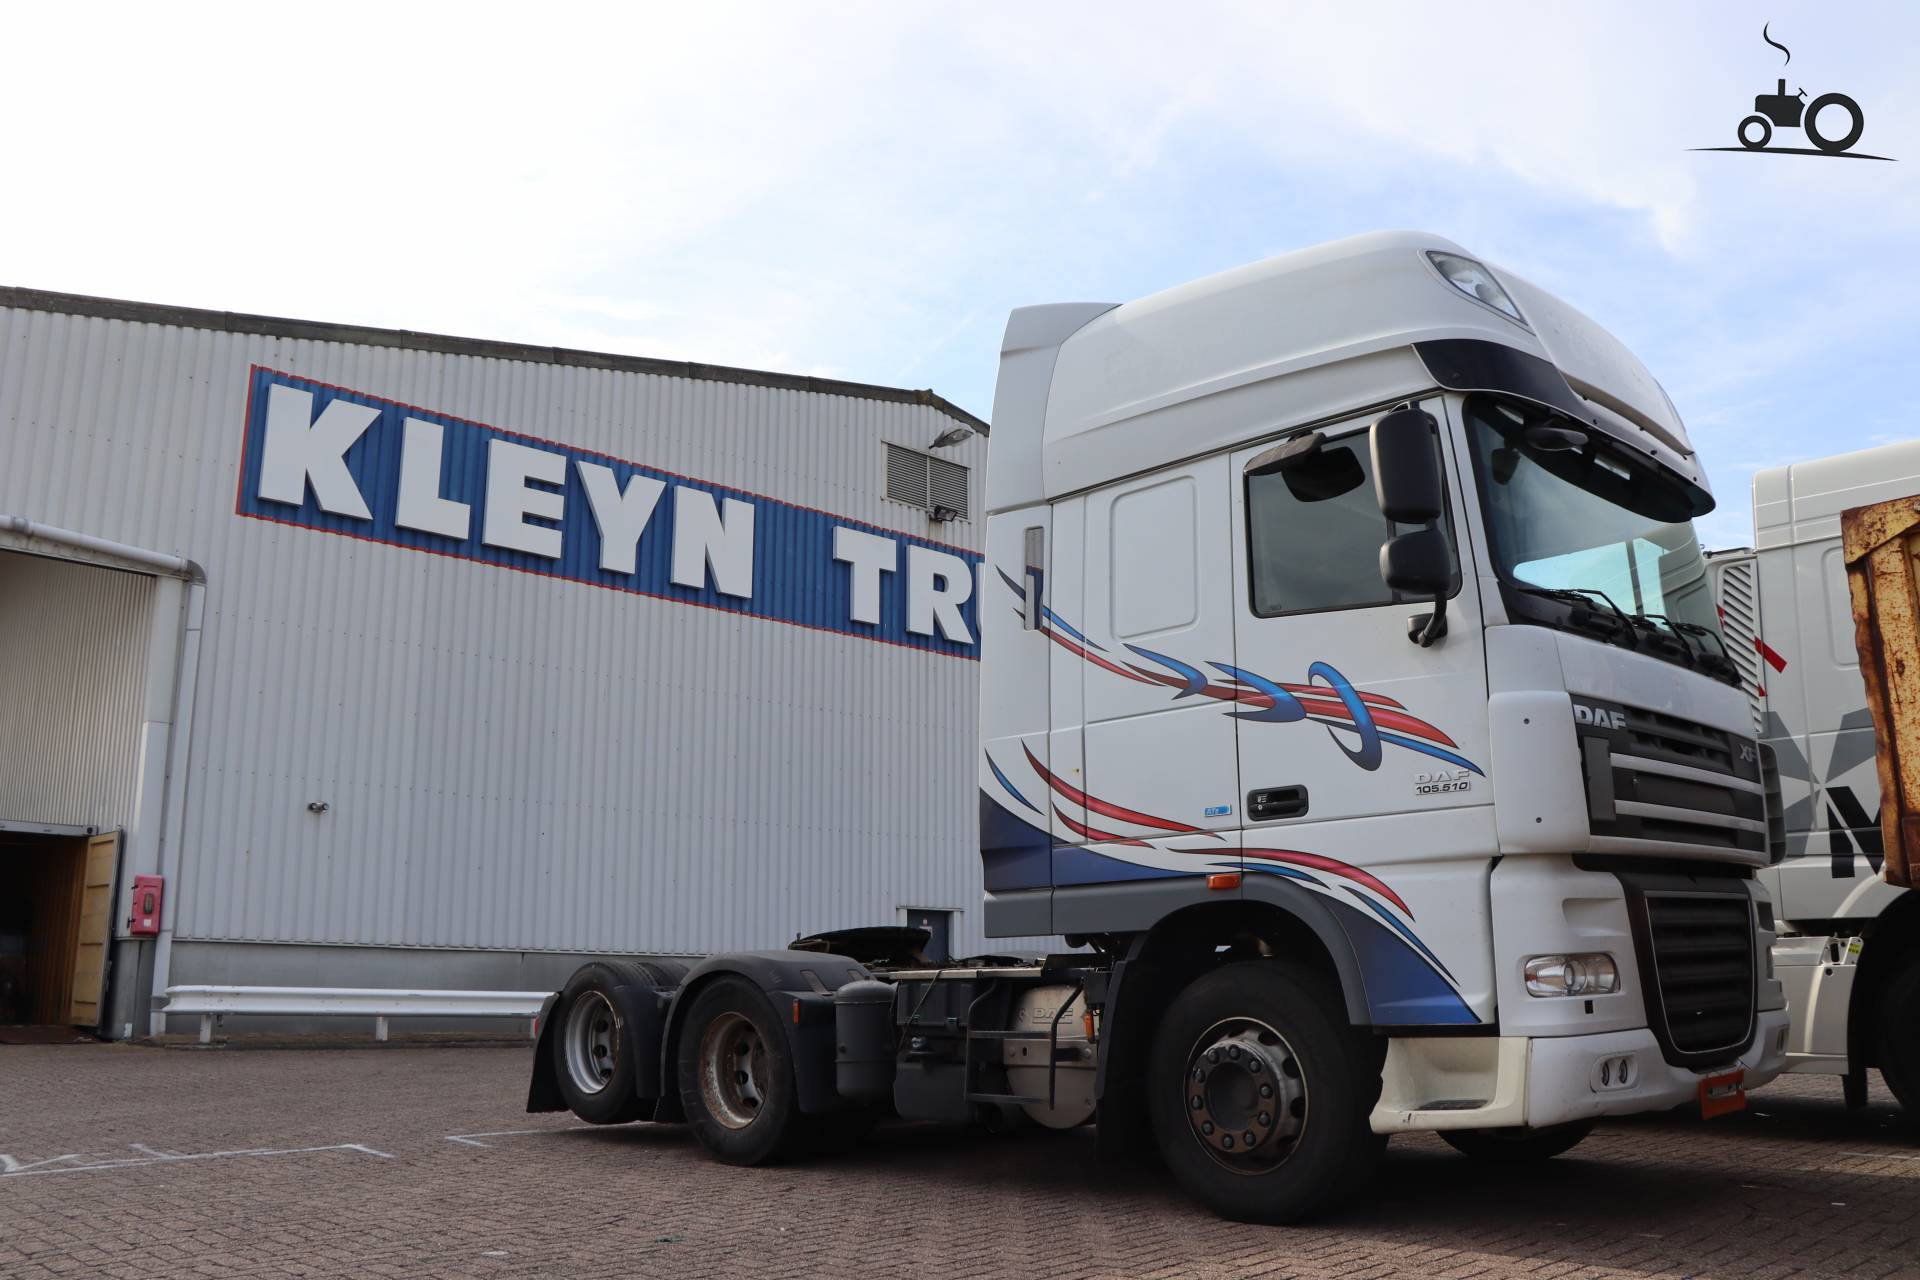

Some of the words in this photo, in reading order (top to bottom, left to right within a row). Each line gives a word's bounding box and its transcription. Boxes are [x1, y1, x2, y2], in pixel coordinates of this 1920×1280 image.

[257, 383, 755, 599] KLEYN
[832, 526, 984, 645] TR
[1573, 703, 1627, 730] DAF
[1415, 769, 1470, 784] DAF
[1416, 781, 1468, 794] 105.510
